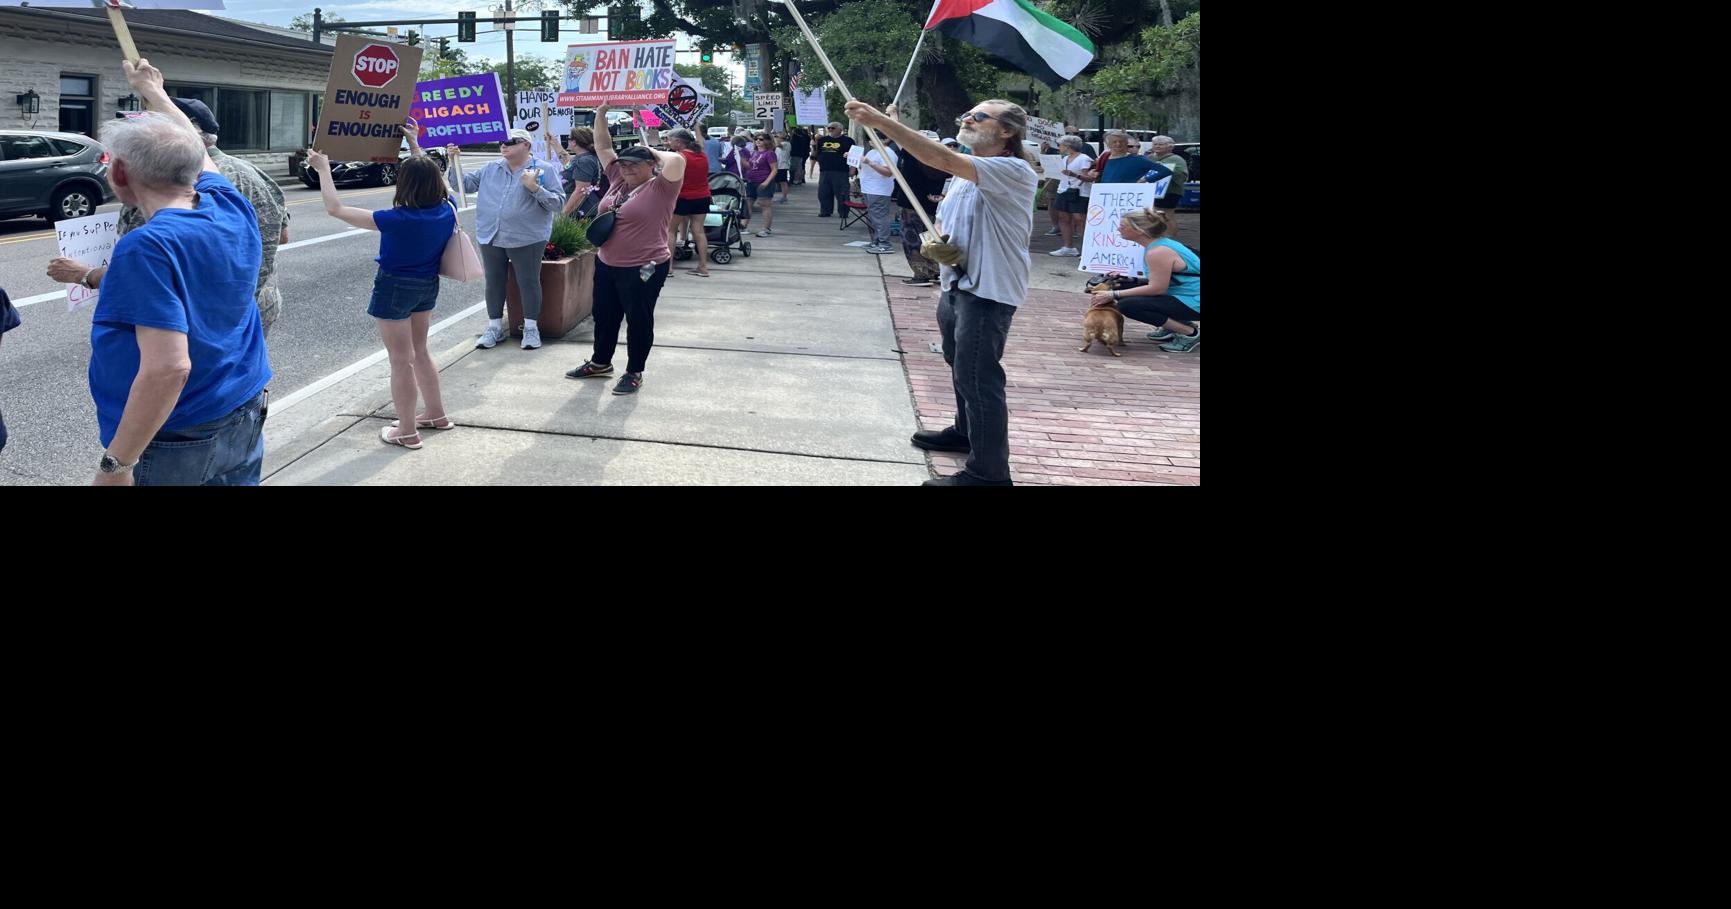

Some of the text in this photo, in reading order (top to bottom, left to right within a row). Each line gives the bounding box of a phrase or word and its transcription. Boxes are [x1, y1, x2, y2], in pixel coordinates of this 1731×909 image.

[356, 56, 397, 74] STOP
[596, 46, 672, 70] BAN HATE
[590, 71, 620, 91] NOT
[625, 68, 671, 90] BOOKS
[335, 89, 400, 109] ENOUGH
[520, 92, 555, 104] HANDS
[359, 110, 371, 120] IS
[410, 103, 490, 120] OLIGACH
[519, 107, 541, 120] OUR
[1100, 192, 1144, 208] THERE
[1090, 252, 1134, 270] AMERICA
